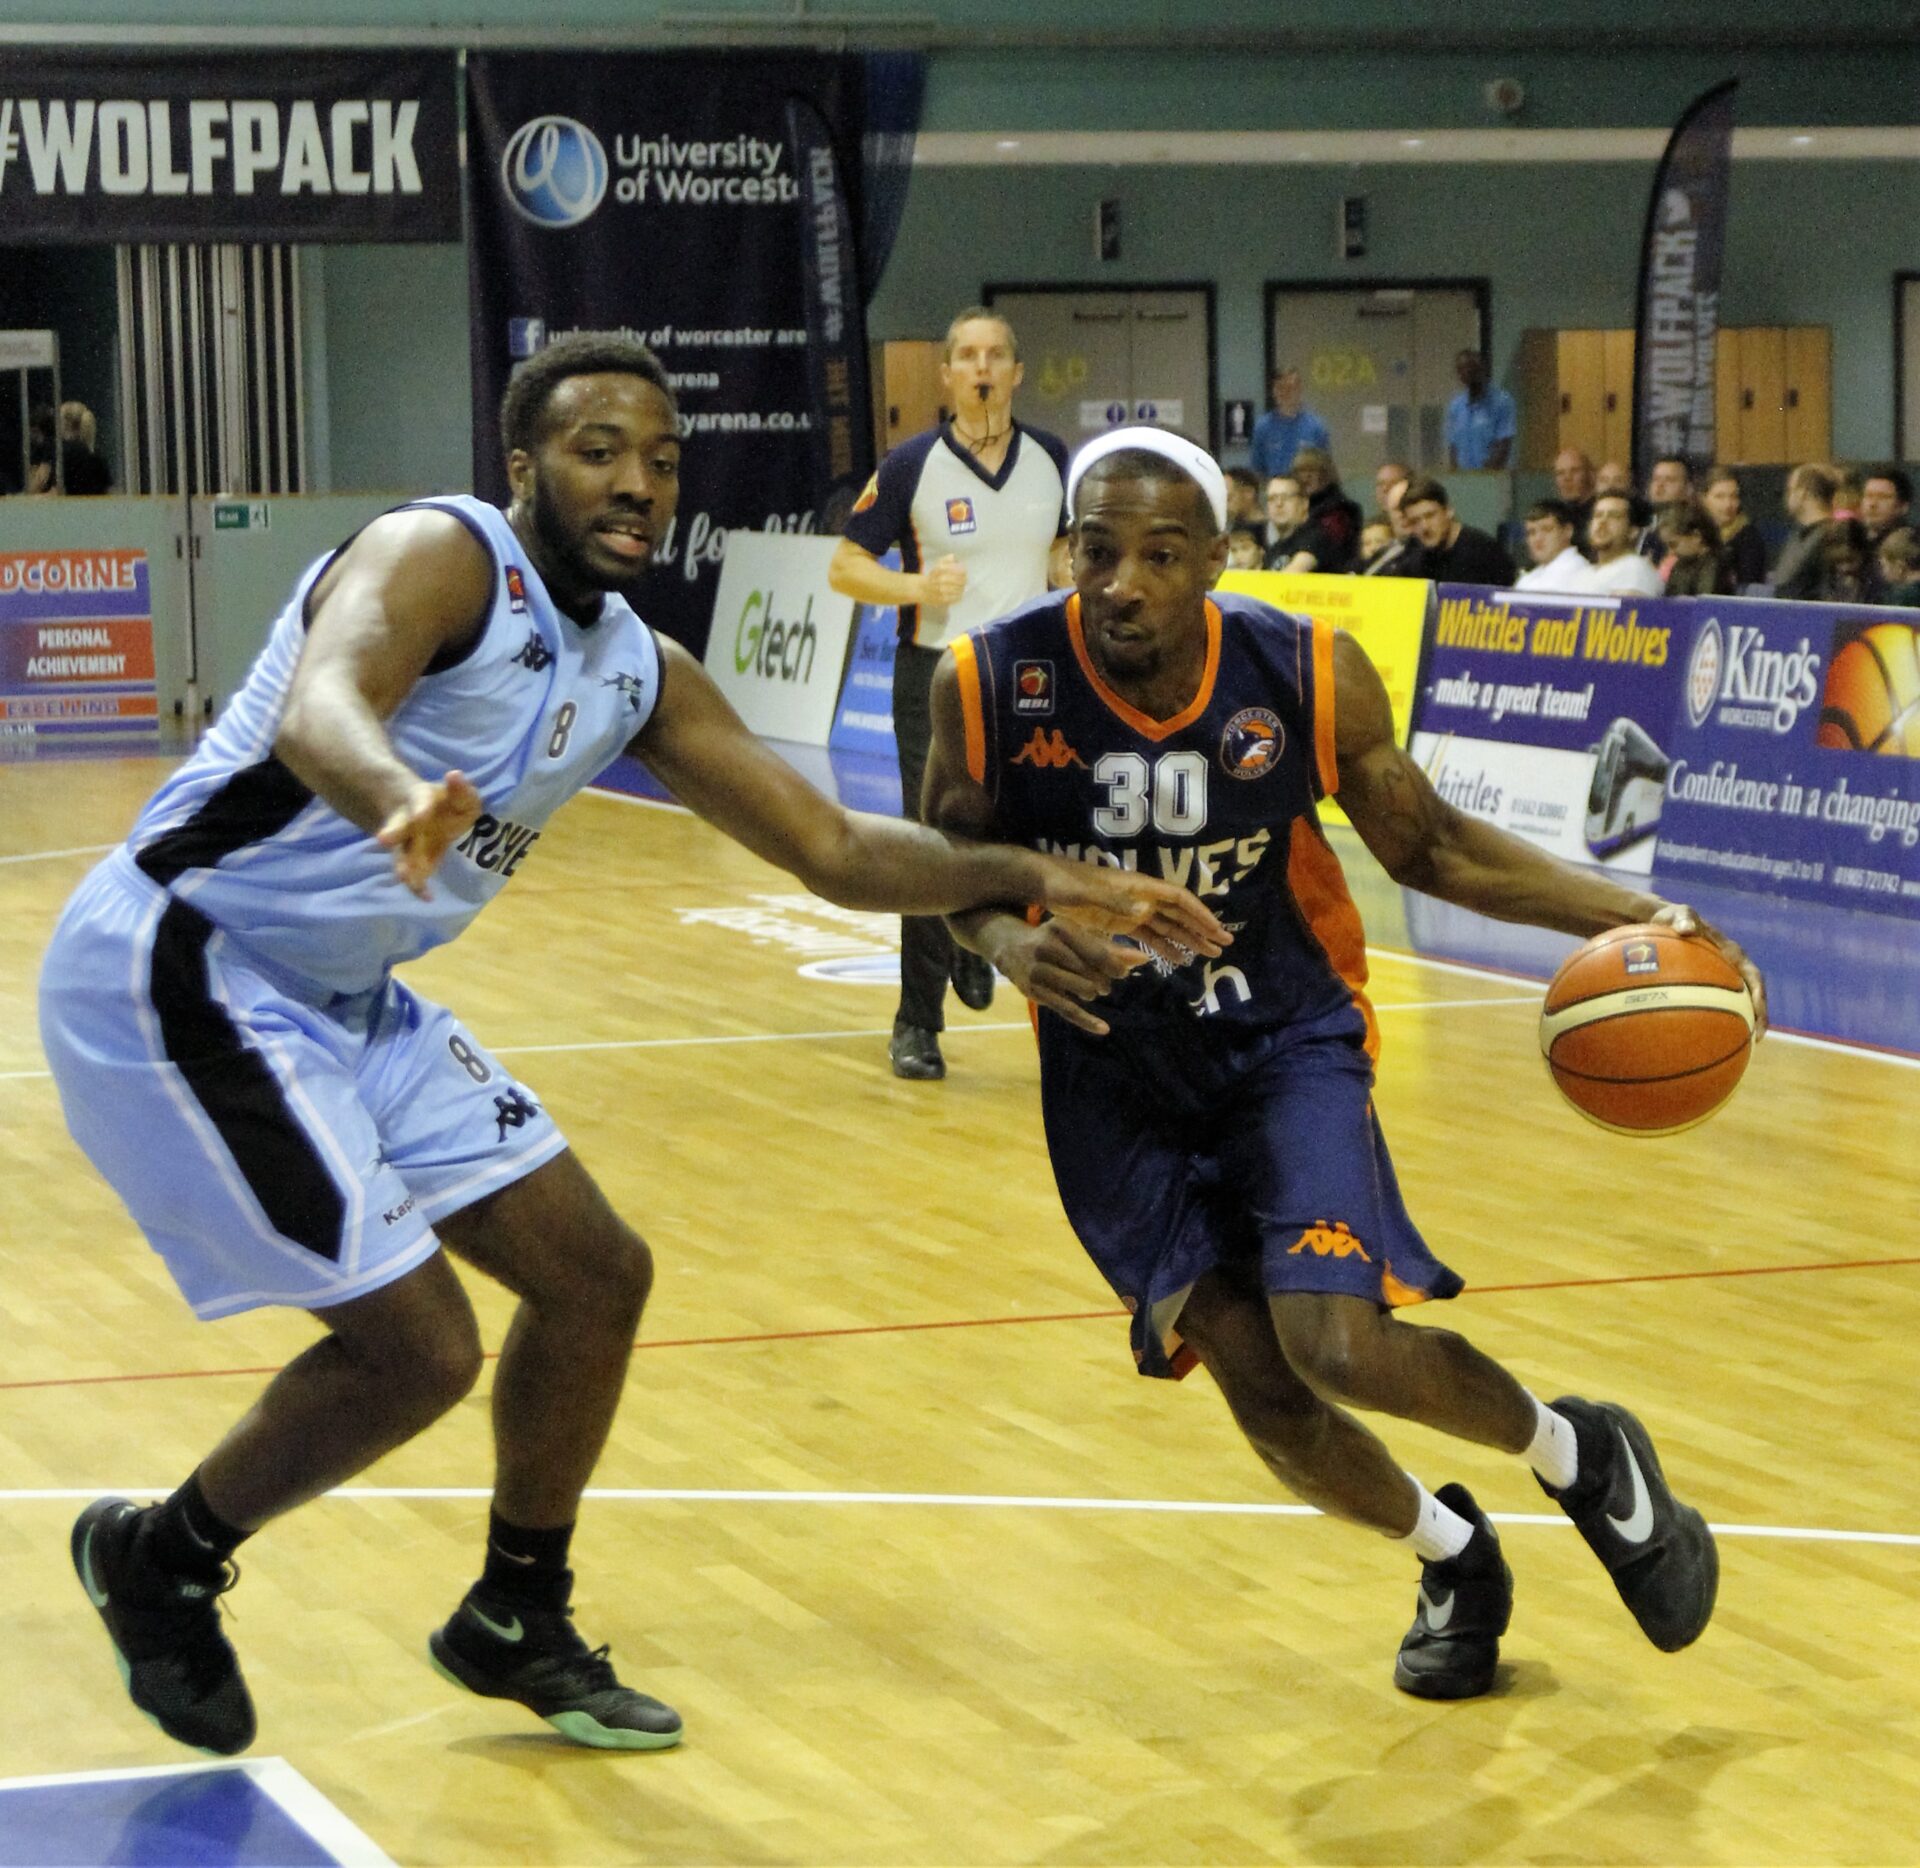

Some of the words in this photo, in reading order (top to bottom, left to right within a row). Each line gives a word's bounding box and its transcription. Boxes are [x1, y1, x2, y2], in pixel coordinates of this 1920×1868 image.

[615, 133, 783, 176] University
[615, 168, 650, 204] of
[650, 325, 672, 345] of
[676, 326, 771, 346] worcester
[38, 628, 112, 650] PERSONAL
[734, 589, 817, 684] Gtech
[1436, 598, 1529, 654] Whittles
[1532, 607, 1584, 658] and
[1584, 607, 1671, 667] Wolves
[26, 655, 126, 678] ACHIEVEMENT
[1720, 625, 1821, 735] King's
[1436, 671, 1480, 708] make
[1482, 683, 1494, 708] a
[1492, 682, 1542, 722] great
[1542, 683, 1595, 720] team!
[548, 700, 577, 758] 8
[1093, 750, 1209, 838] 30
[1668, 759, 1778, 812] Confidence
[1780, 773, 1804, 816] in
[1806, 788, 1821, 818] a
[1823, 778, 1920, 847] changing
[448, 1033, 493, 1086] 8
